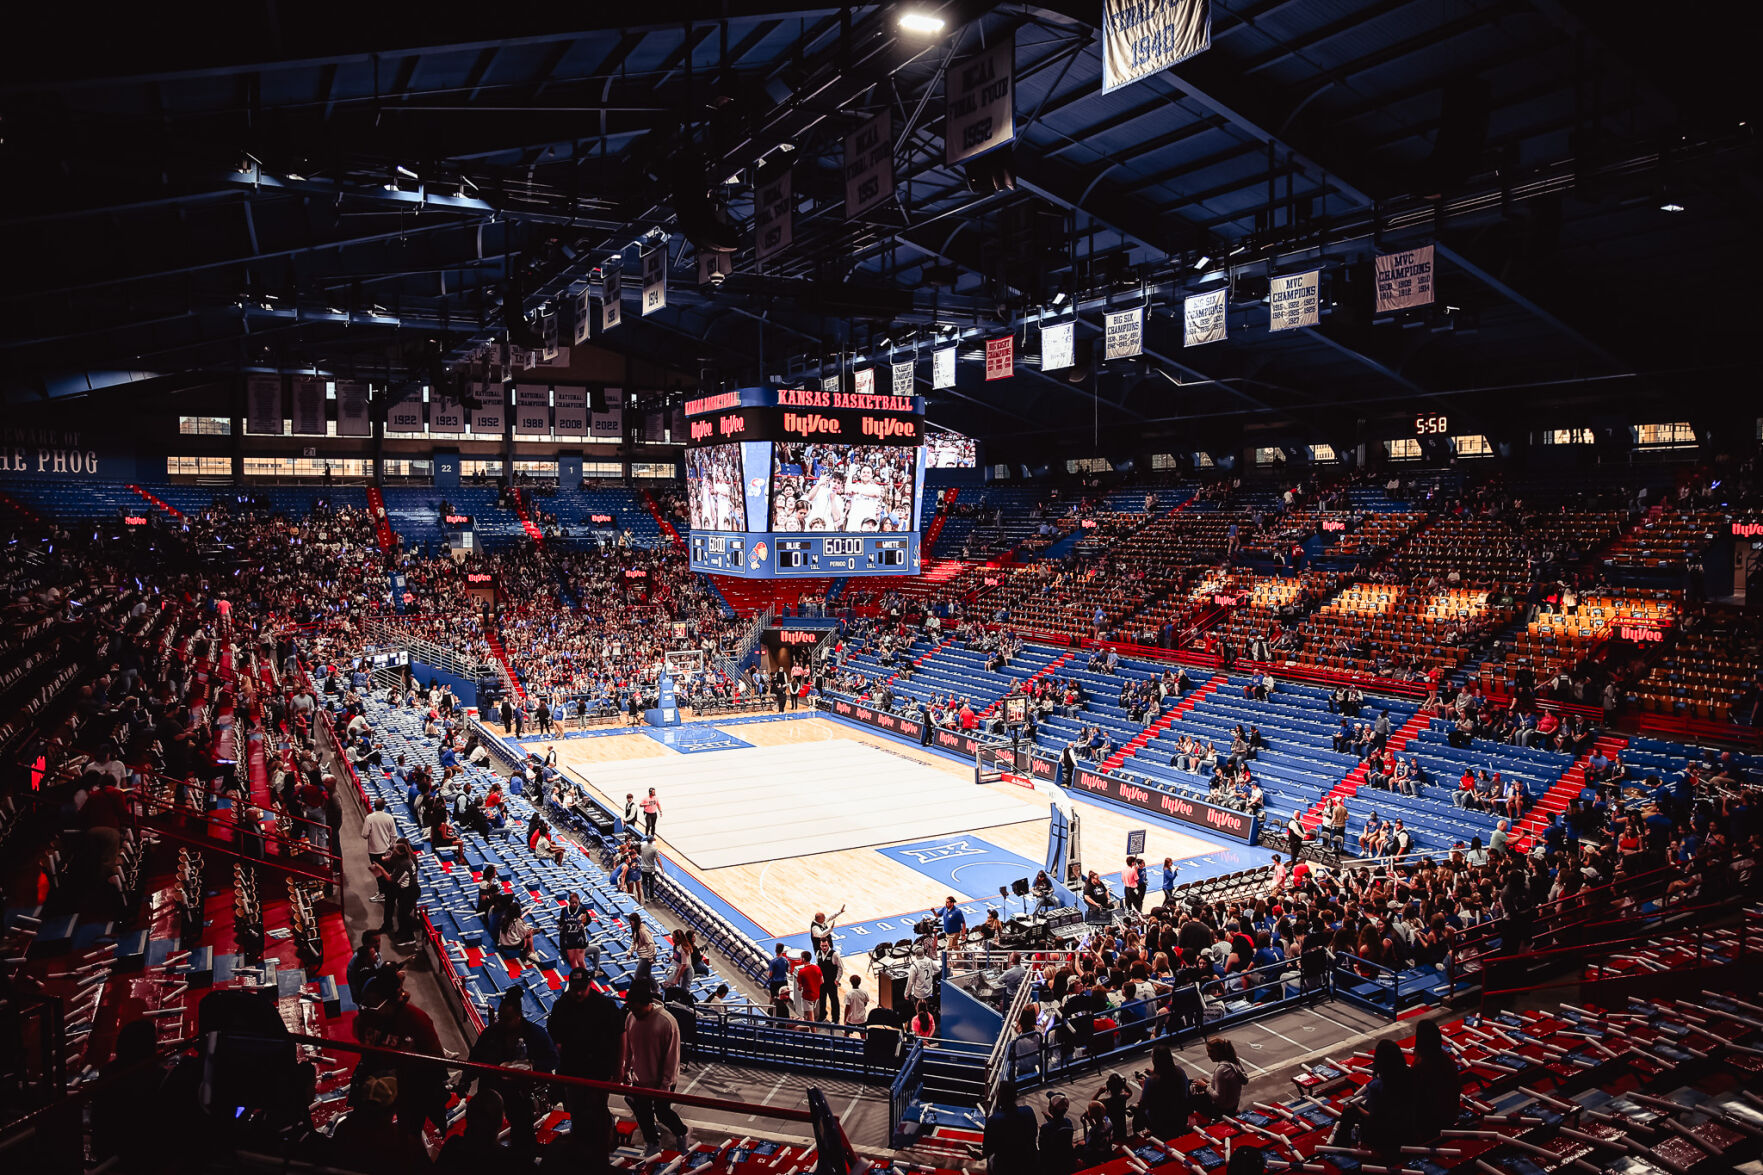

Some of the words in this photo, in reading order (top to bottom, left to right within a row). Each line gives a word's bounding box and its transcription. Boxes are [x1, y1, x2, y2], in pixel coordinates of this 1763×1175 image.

[1131, 24, 1175, 69] 1940
[981, 76, 1009, 108] FOUR
[964, 117, 993, 150] 1952
[1394, 253, 1414, 267] MVC
[1379, 262, 1431, 282] CHAMPIONS
[1286, 277, 1303, 289] MVC
[1273, 286, 1316, 302] CHAMPIONS
[1113, 316, 1123, 325] BIG
[1124, 313, 1134, 323] SIX
[1107, 321, 1140, 335] CHAMPIONS
[777, 389, 830, 407] KANSAS
[832, 392, 914, 412] BASKETBALL
[394, 415, 417, 425] 1922
[435, 416, 458, 426] 1923
[559, 419, 582, 429] 2008
[595, 421, 618, 430] 2022
[1417, 417, 1447, 434] 5:58
[37, 447, 98, 474] PHOG
[441, 464, 452, 473] 22
[569, 466, 574, 475] 1
[786, 542, 800, 550] BLUE
[825, 538, 862, 554] 60:00
[791, 551, 801, 567] 0
[848, 557, 855, 570] 0
[895, 549, 904, 565] 0
